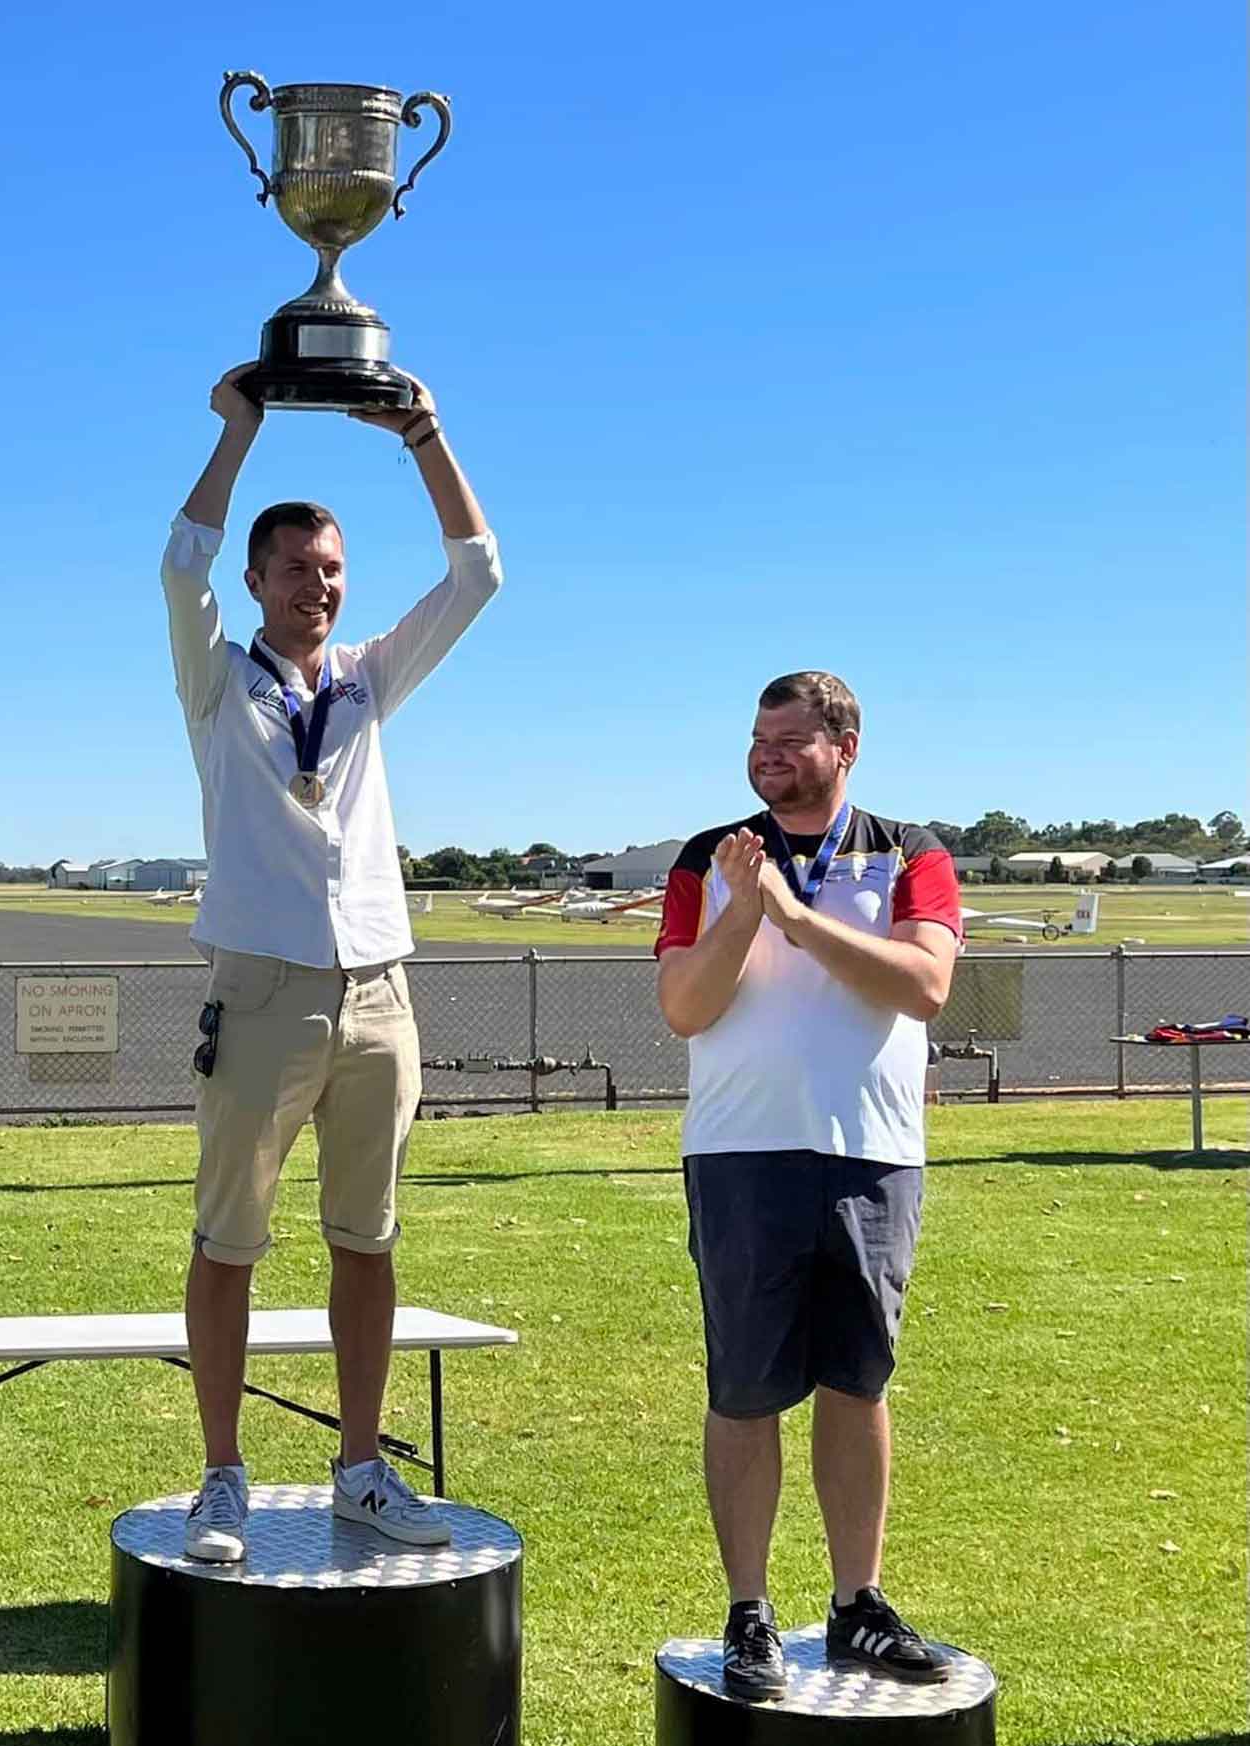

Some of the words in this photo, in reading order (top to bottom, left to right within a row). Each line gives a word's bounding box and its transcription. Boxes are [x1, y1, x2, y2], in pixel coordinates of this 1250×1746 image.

[22, 984, 46, 998] NO
[49, 984, 114, 998] SMOKING
[29, 1004, 52, 1017] ON
[58, 1004, 107, 1017] APRON
